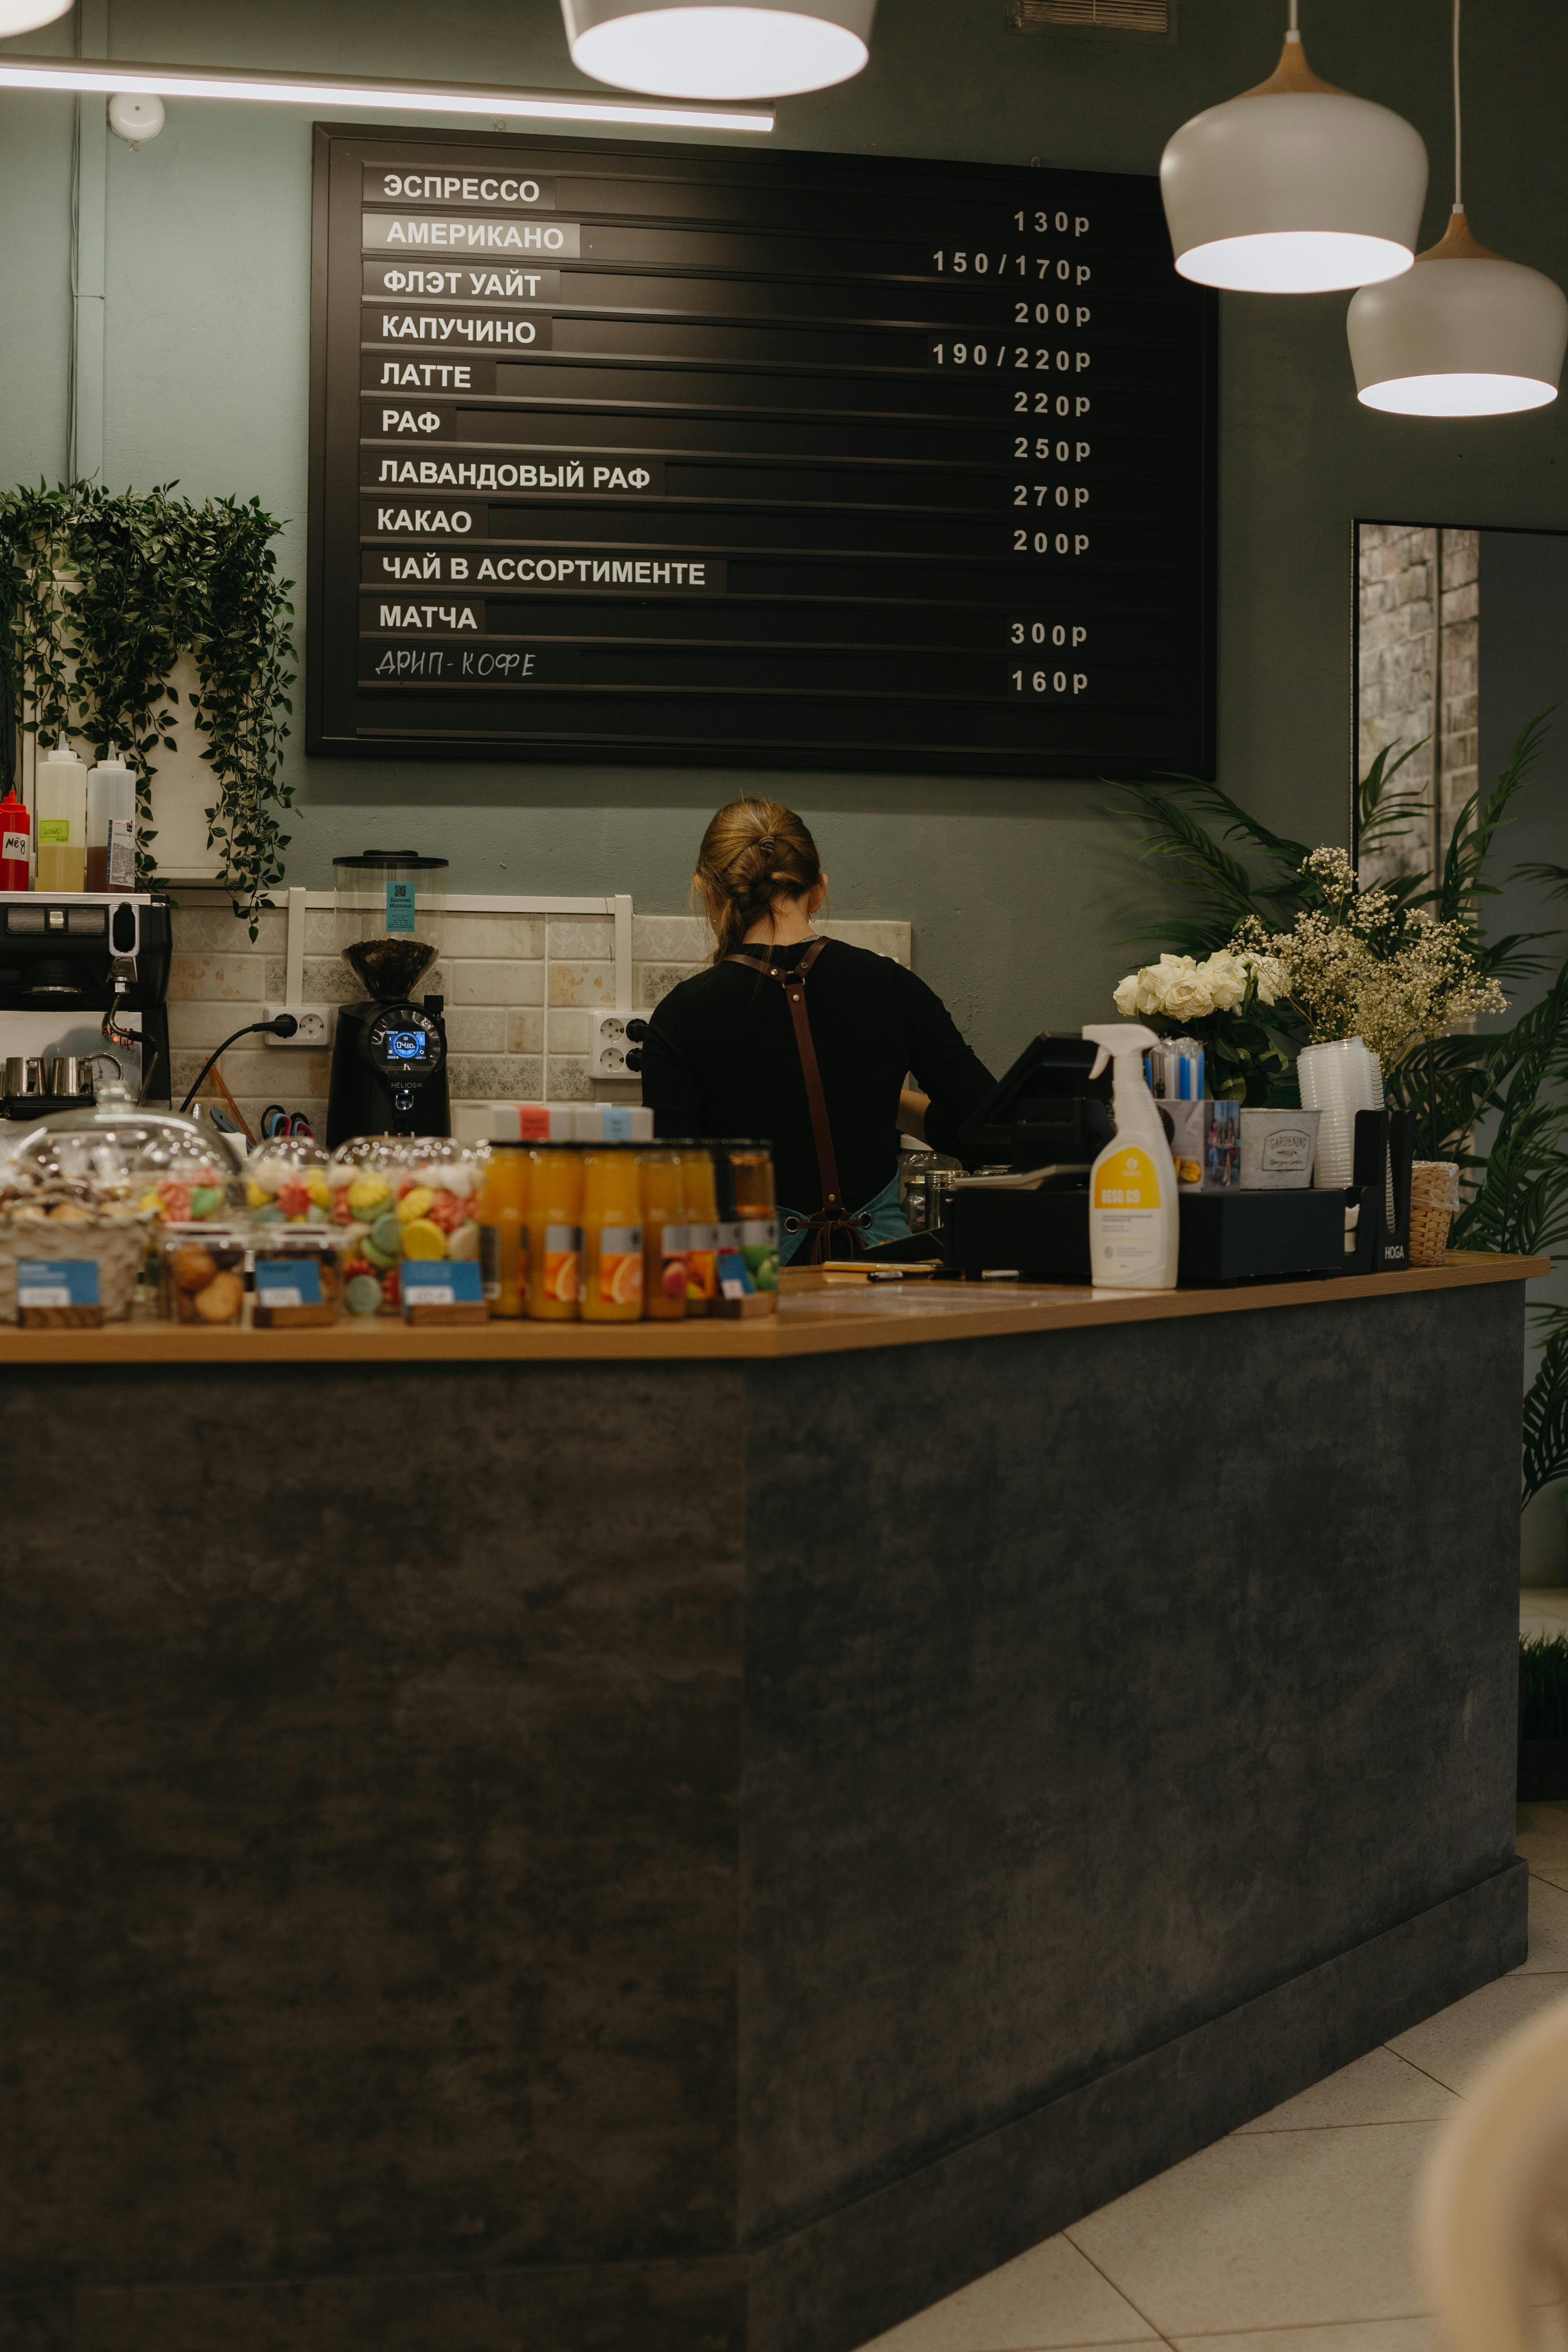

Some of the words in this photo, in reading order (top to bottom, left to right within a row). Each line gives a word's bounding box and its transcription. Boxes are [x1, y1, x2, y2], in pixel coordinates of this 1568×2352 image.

[384, 175, 539, 201] ЭСПРЕССО
[386, 222, 564, 249] АМЕРИКАНО
[384, 270, 461, 294] ФЛЭТ
[470, 270, 541, 296] УАЙТ
[382, 316, 536, 343] КАПУЧИНО
[381, 363, 471, 388] ЛАТТЕ
[382, 410, 440, 433] РАФ
[379, 460, 584, 489] ЛАВАНДОВЫЙ
[593, 467, 650, 489] РАФ
[378, 509, 471, 532] КАКАО
[383, 553, 440, 579] ЧАЙ
[451, 561, 468, 579] В
[477, 559, 705, 585] АССОРТИМЕНТЕ
[380, 605, 478, 629] МАТЧА
[1385, 1245, 1404, 1259] HOGA
